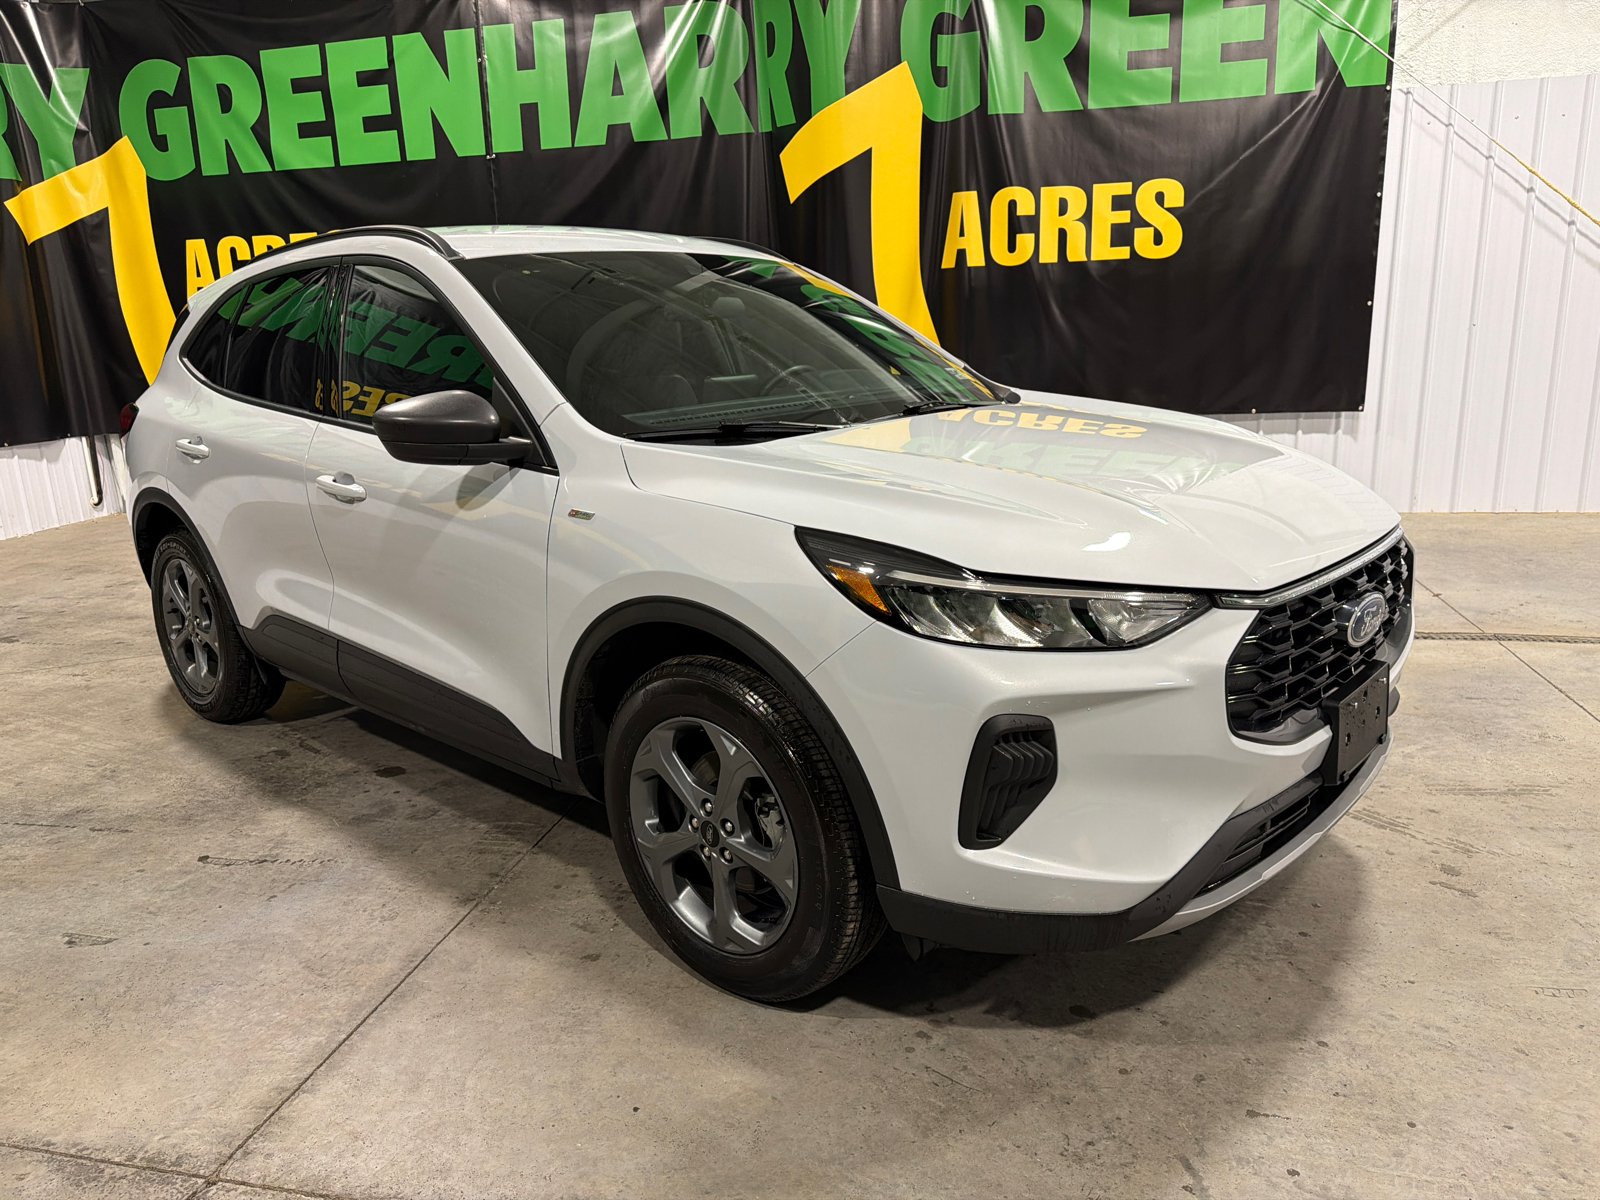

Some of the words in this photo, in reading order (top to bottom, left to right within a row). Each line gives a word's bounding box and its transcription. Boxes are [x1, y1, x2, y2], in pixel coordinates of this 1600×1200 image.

[119, 28, 487, 181] GREEN
[483, 0, 861, 153] HARRY
[900, 0, 1392, 122] GREEN
[5, 136, 177, 386] 7
[779, 60, 941, 347] 7
[941, 177, 1185, 269] ACRES
